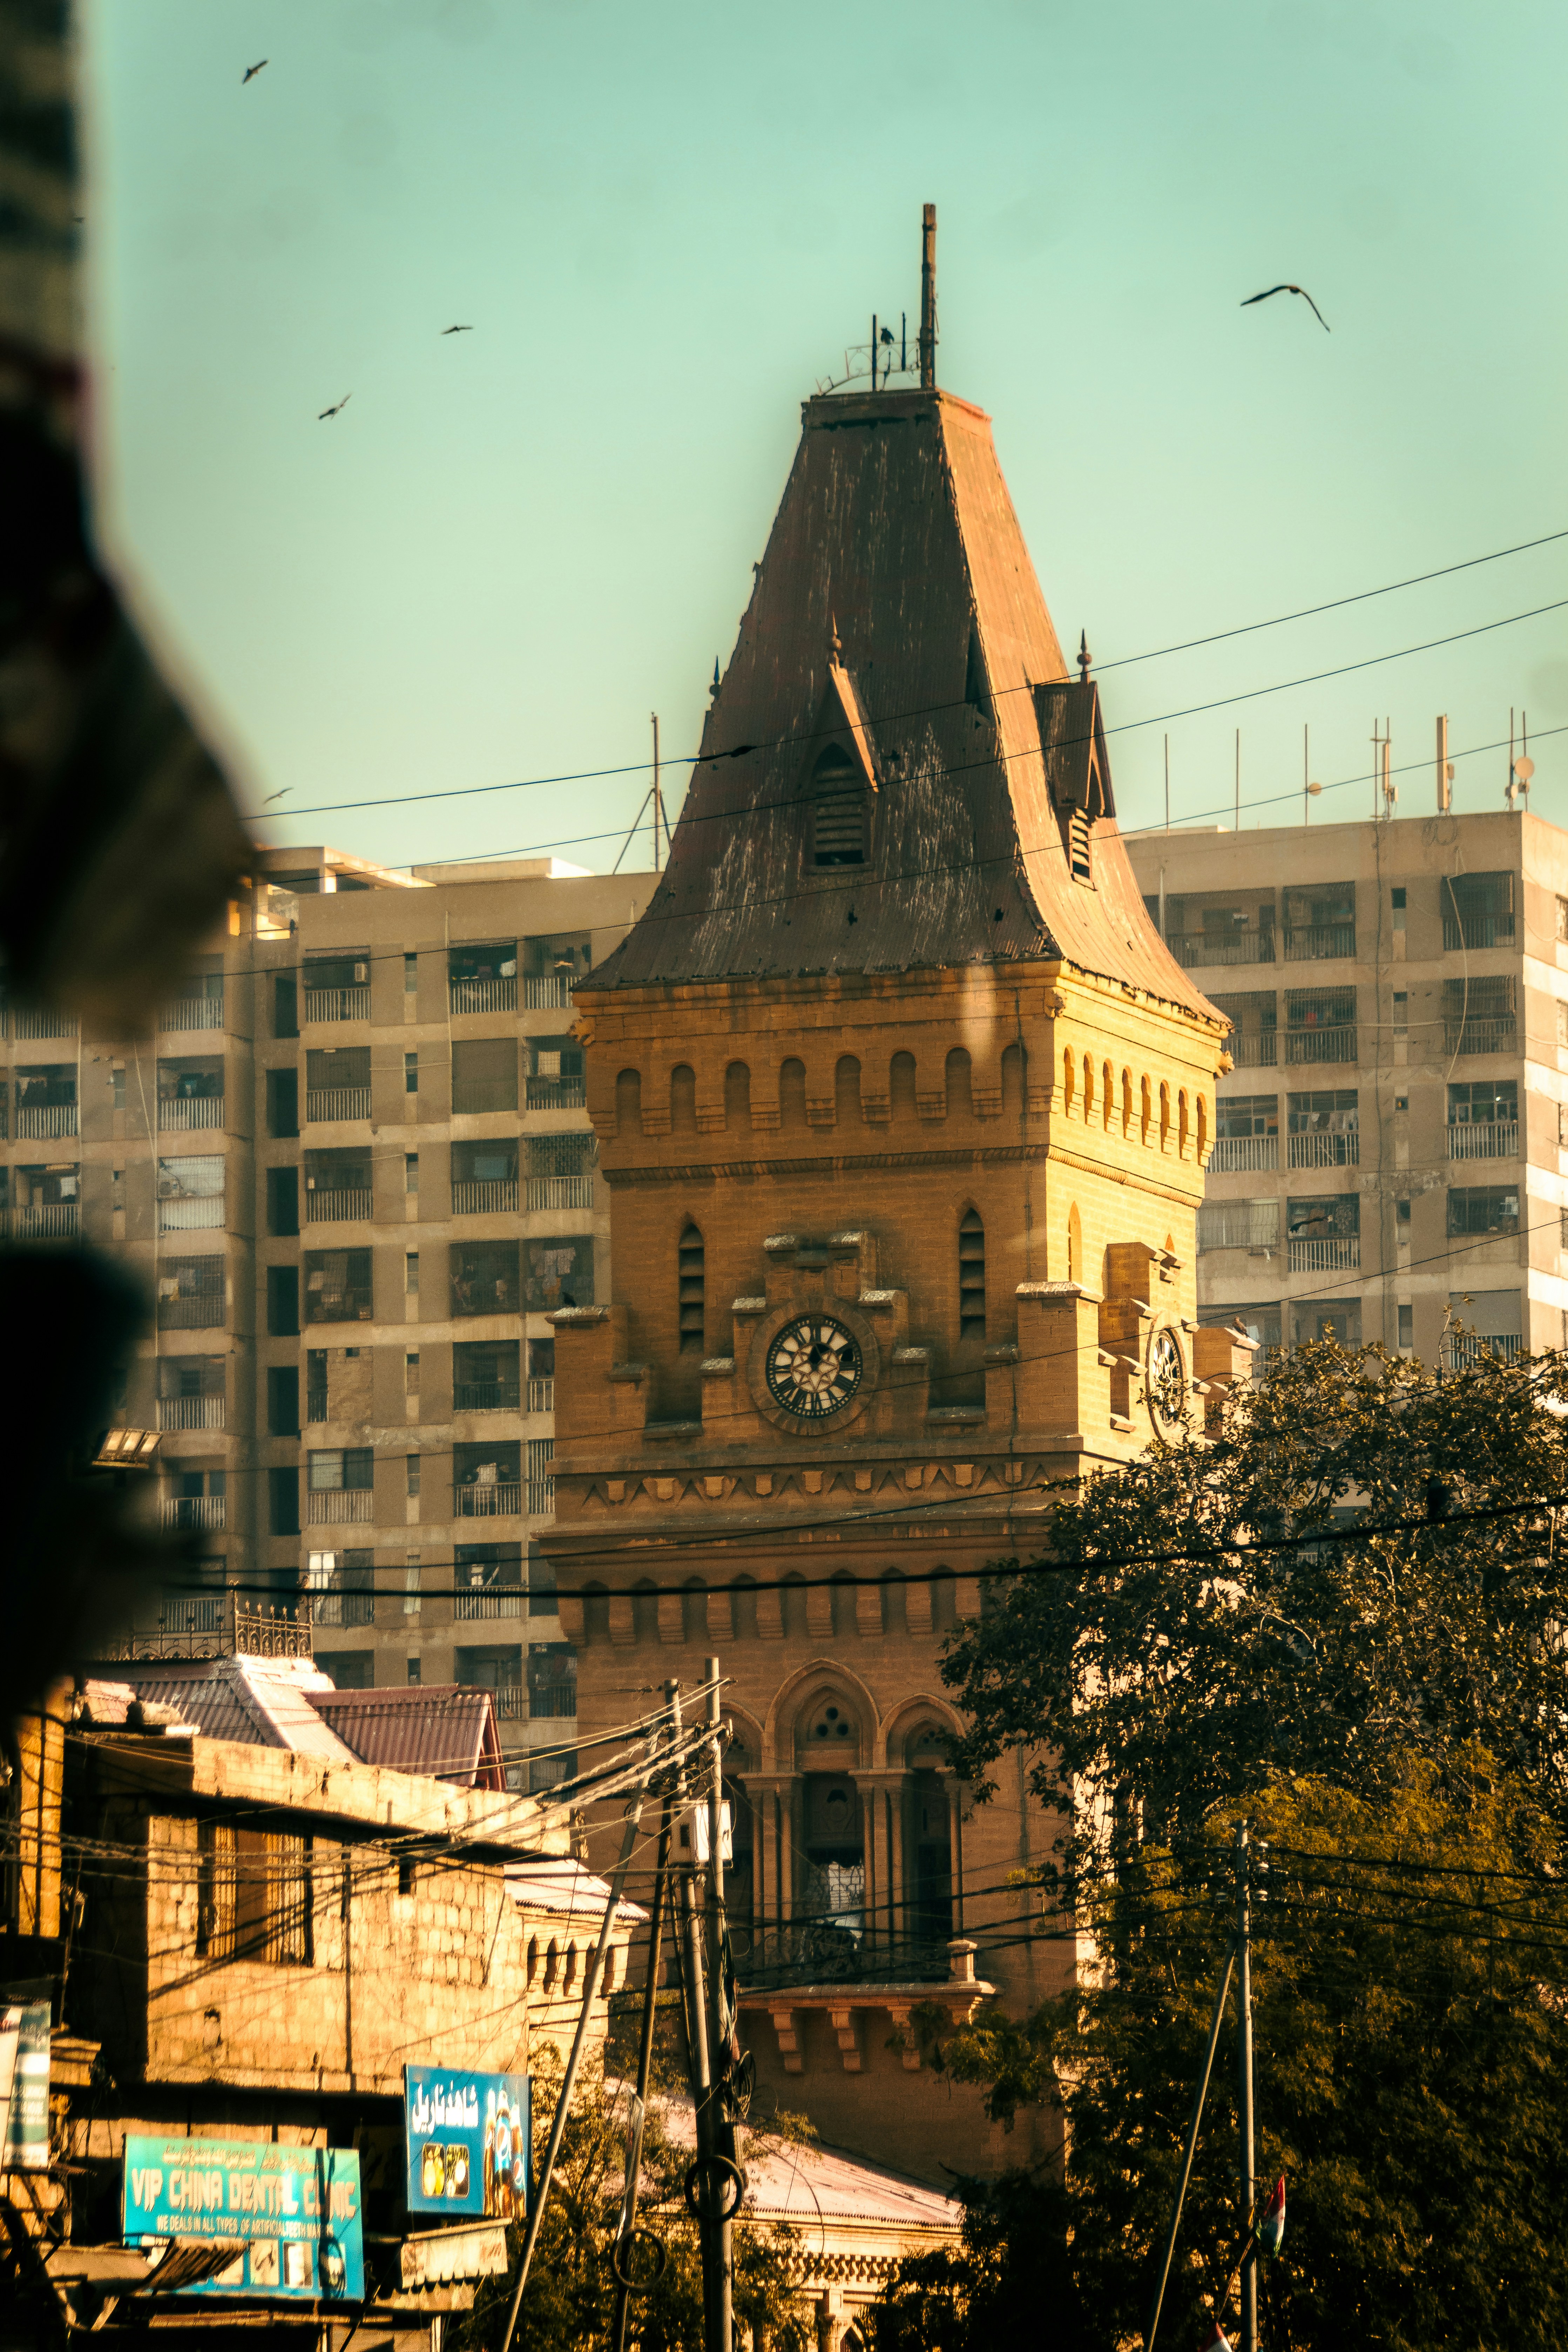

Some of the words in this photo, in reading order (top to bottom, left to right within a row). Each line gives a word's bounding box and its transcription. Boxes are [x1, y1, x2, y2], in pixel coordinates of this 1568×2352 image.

[132, 2168, 163, 2212] VIP
[169, 2170, 223, 2213] CHINA
[229, 2173, 298, 2217] DENTAL
[303, 2178, 356, 2222] CLNIC
[157, 2215, 168, 2231] WE
[170, 2215, 192, 2232] DEALS
[194, 2216, 201, 2232] IN
[202, 2216, 215, 2233] ALL
[216, 2216, 238, 2234] TYPES
[241, 2219, 250, 2235] OF
[251, 2219, 286, 2237] ARTIFICIAL
[285, 2221, 305, 2238] TEETH
